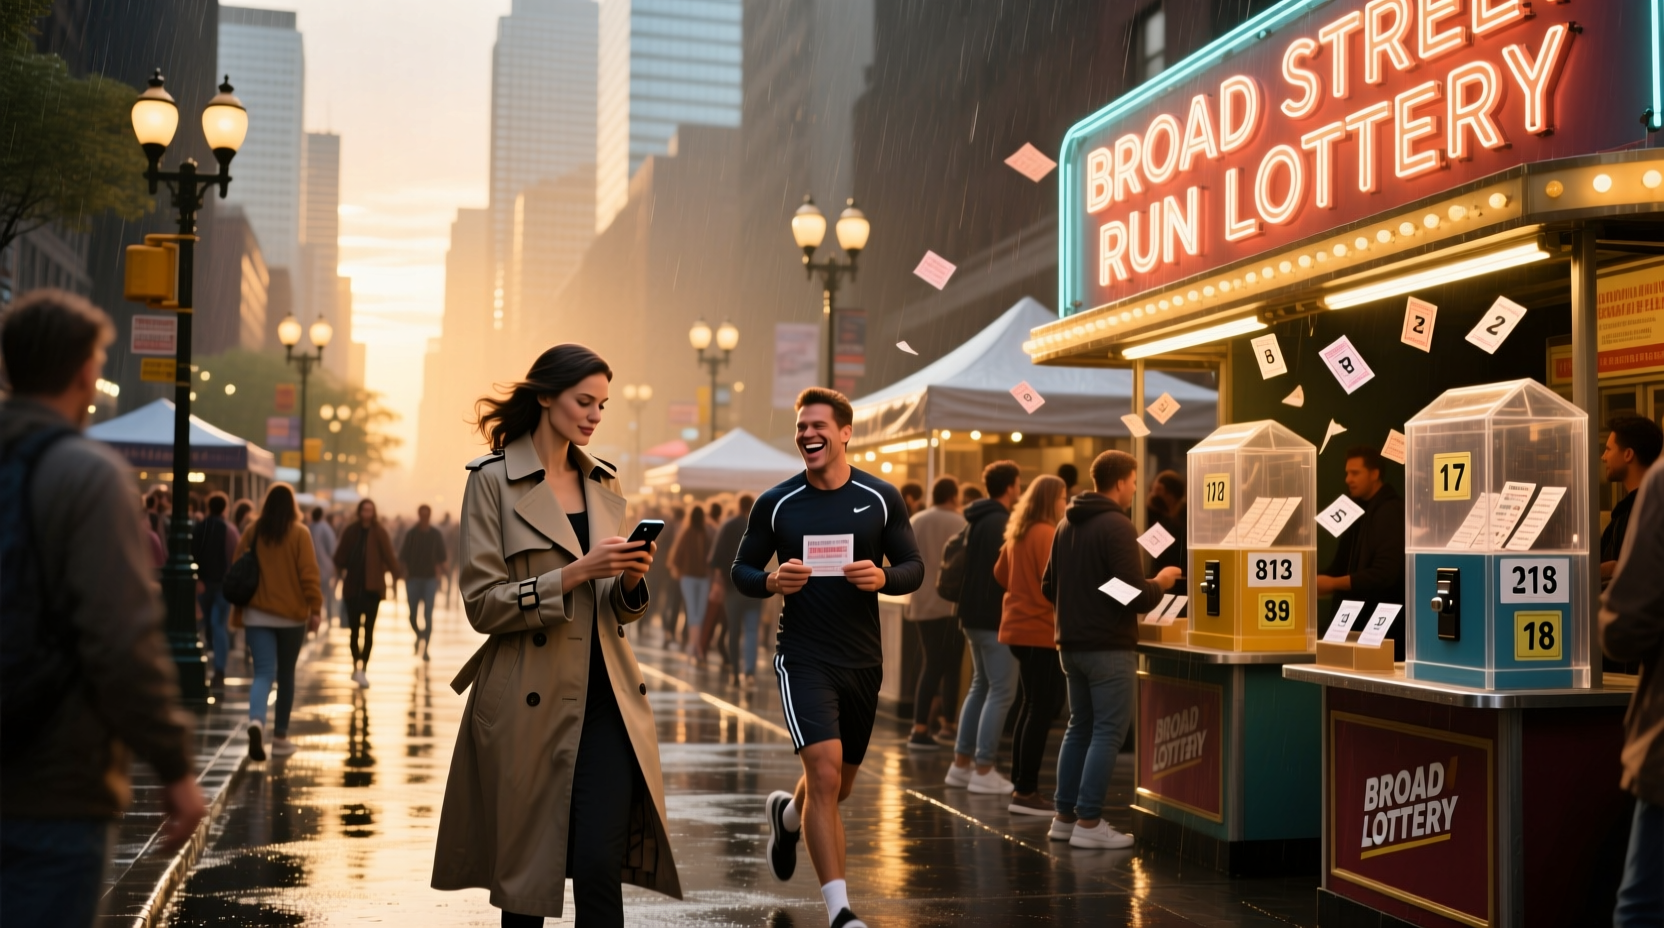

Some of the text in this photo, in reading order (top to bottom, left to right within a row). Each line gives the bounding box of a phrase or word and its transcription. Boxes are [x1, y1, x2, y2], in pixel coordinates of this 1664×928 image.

[1087, 0, 1557, 213] BROAD STRE
[1099, 24, 1566, 287] RUN LOTTERY
[1485, 315, 1507, 336] 2
[1440, 462, 1466, 492] 17
[1255, 558, 1293, 581] 813
[1523, 620, 1555, 651] 18
[1154, 705, 1199, 744] BROAD
[1363, 761, 1445, 812] BROAD
[1361, 795, 1459, 848] LOTTERY
